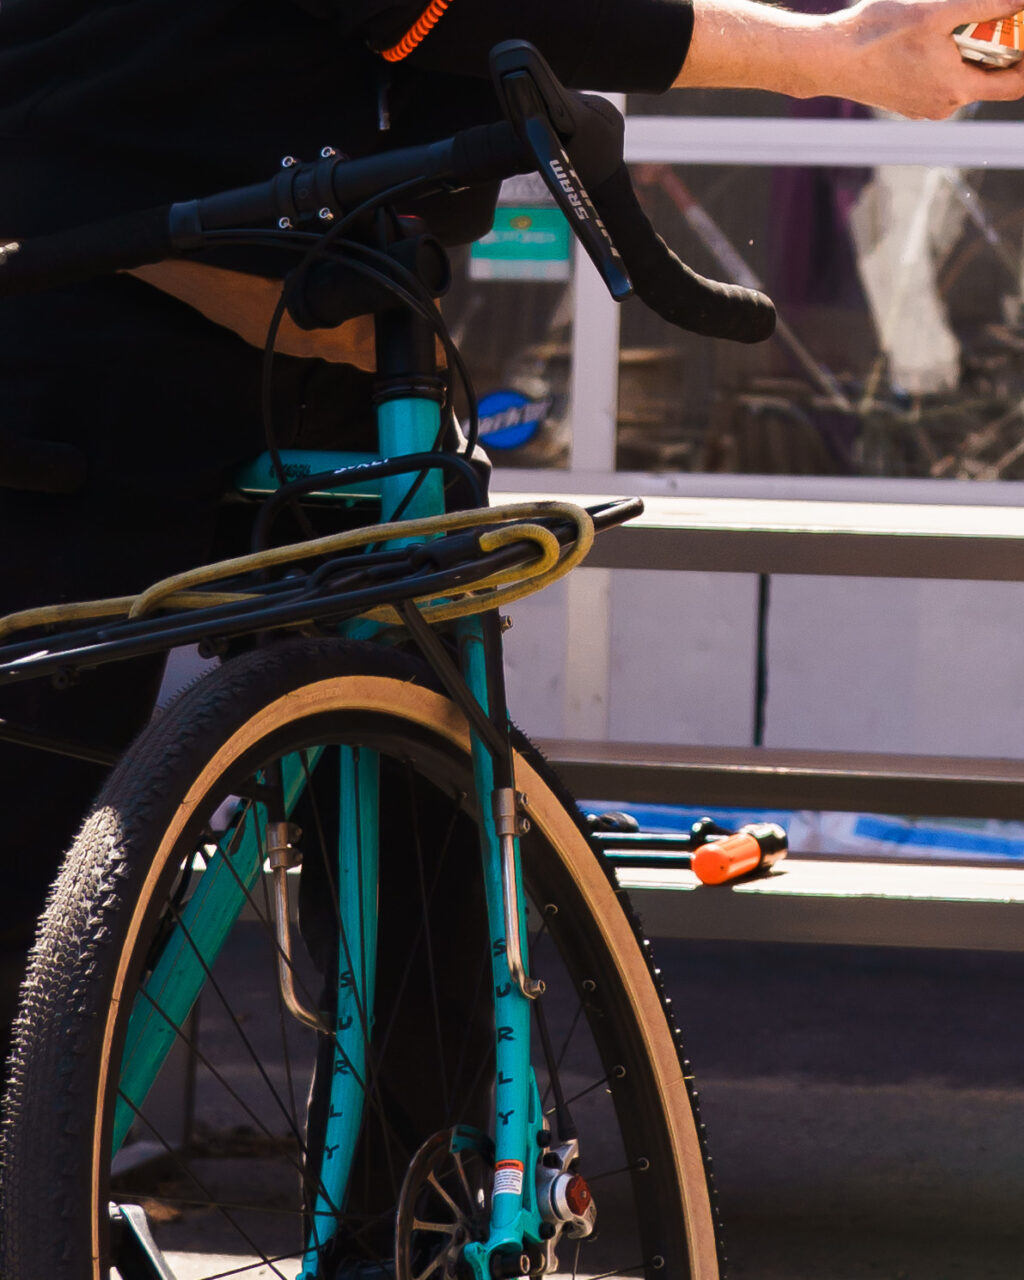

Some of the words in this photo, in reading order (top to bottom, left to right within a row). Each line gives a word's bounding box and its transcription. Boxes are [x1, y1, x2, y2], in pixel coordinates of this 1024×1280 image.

[549, 159, 589, 220] SRAM
[324, 970, 353, 1160] SURLY
[494, 936, 516, 1126] SURLY
